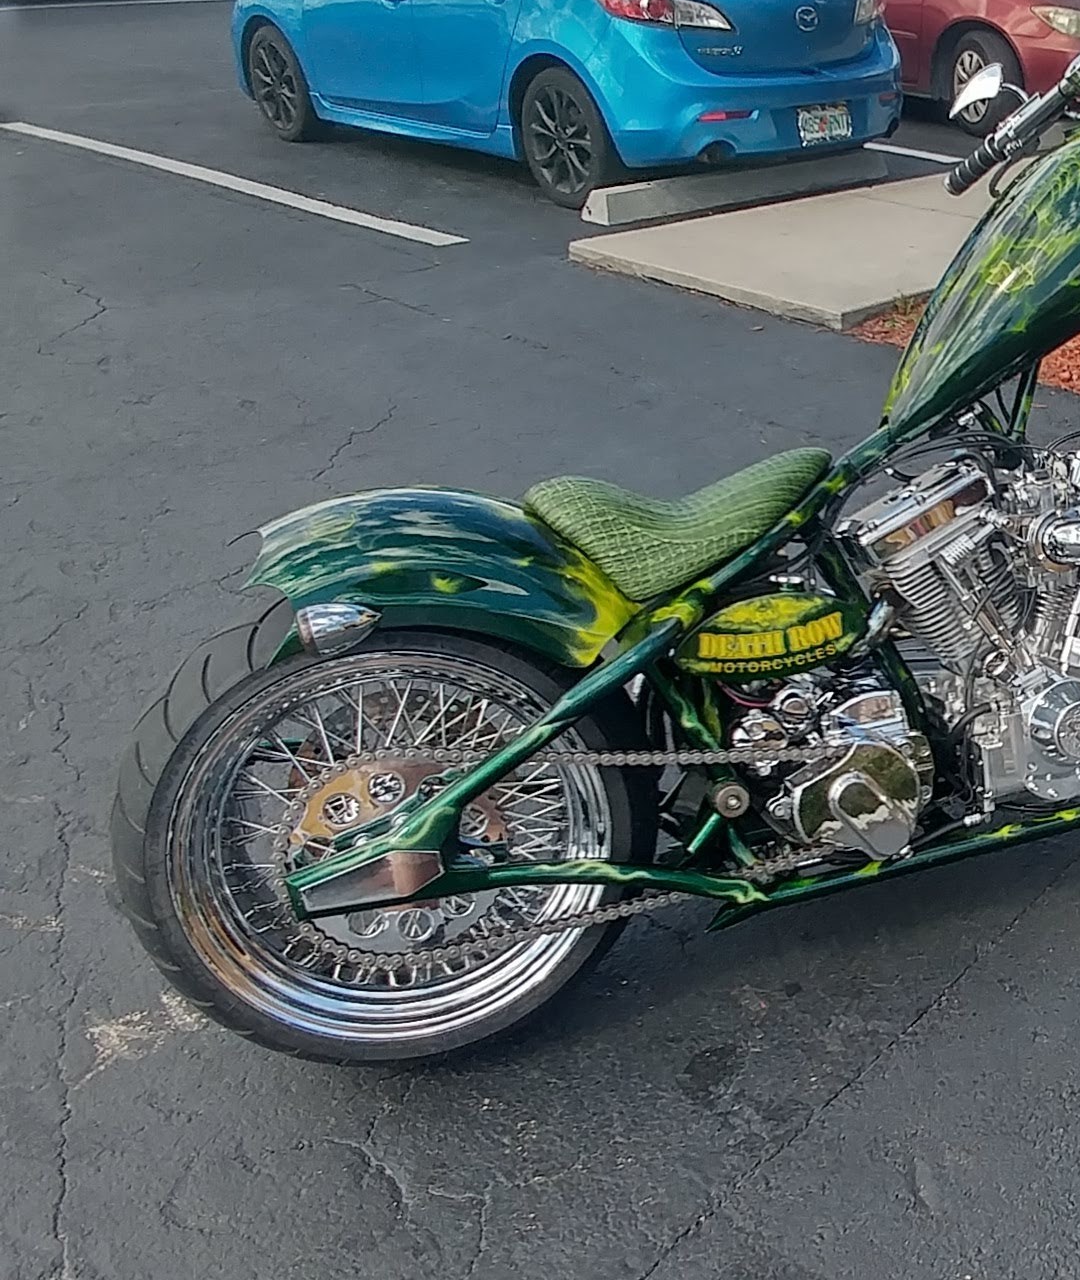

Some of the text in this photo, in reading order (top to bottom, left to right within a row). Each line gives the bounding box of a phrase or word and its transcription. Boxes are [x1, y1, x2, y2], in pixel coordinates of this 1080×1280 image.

[698, 611, 843, 660] DEATH ROW
[711, 644, 837, 674] MOTORCYCLES
